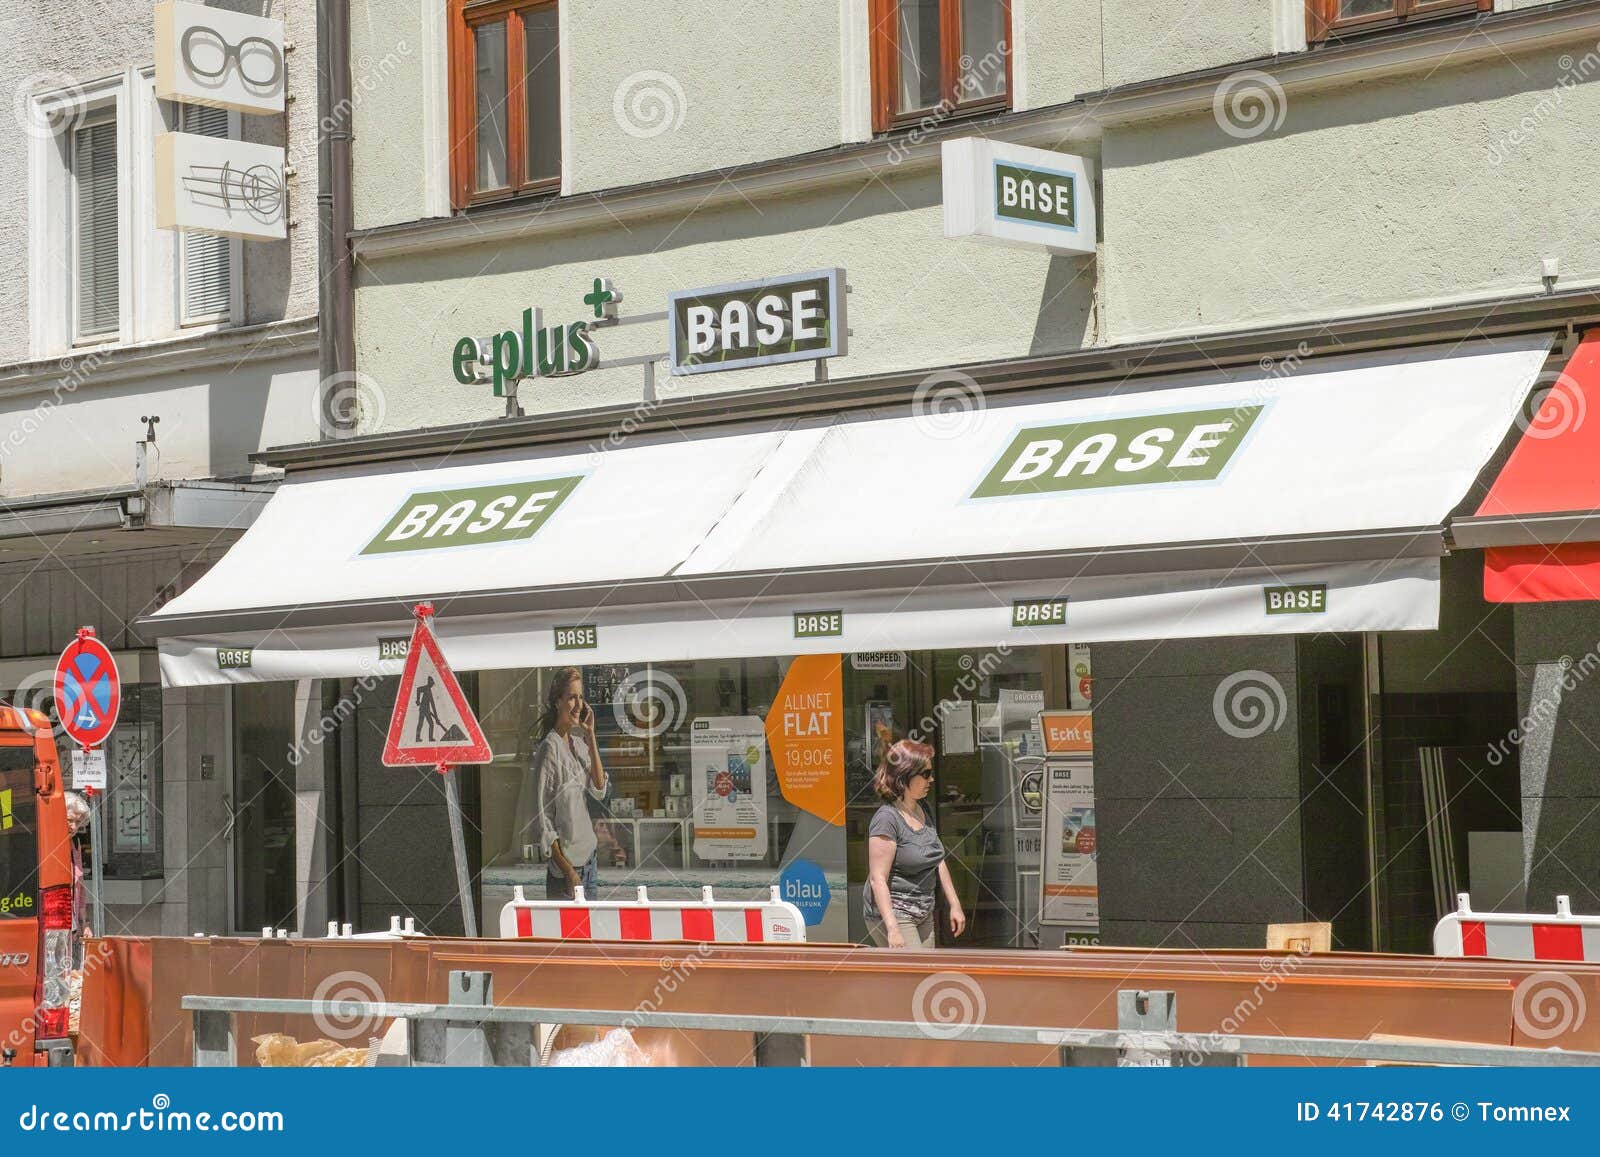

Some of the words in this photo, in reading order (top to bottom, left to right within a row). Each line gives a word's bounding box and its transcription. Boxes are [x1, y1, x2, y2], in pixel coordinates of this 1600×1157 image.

[1003, 175, 1069, 216] BASE
[687, 289, 820, 354] BASE
[1001, 422, 1233, 482] BASE
[385, 490, 559, 541] BASE
[1269, 589, 1322, 609] BASE
[1016, 603, 1063, 622] BASE
[797, 615, 839, 633] BASE
[557, 629, 594, 646] BASE
[382, 640, 410, 655] BAS
[219, 650, 250, 666] BASE
[784, 693, 832, 710] ALLNET
[784, 711, 832, 736] FLAT
[1050, 727, 1080, 741] Echt
[785, 880, 822, 898] blau
